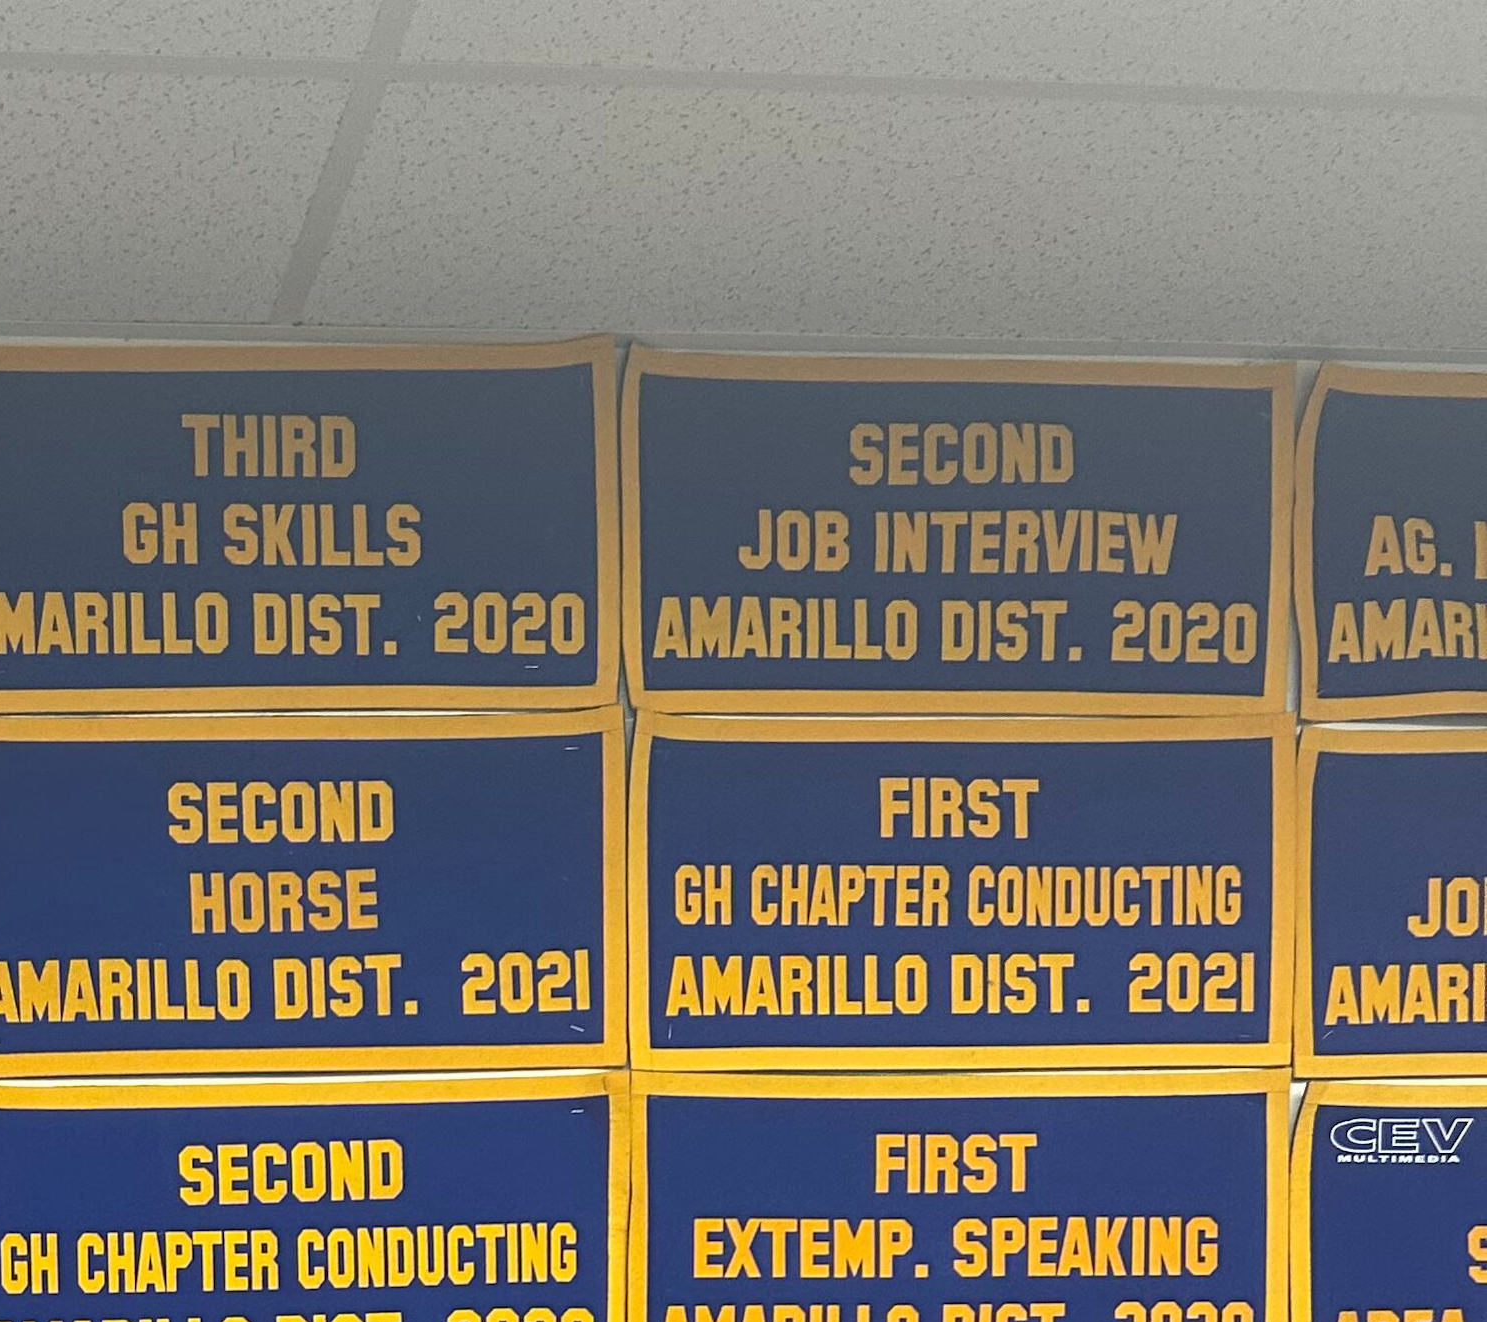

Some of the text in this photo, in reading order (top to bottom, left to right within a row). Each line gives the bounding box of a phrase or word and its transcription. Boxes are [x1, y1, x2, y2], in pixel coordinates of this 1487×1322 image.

[185, 415, 355, 477] THIRD
[850, 424, 1072, 484] SECOND
[123, 503, 421, 566] GH SKILLS
[739, 509, 1177, 574] JOB INTERVIEW
[1365, 516, 1452, 576] AG.
[253, 593, 397, 655] DIST.
[434, 592, 585, 654] 2020
[653, 596, 1257, 664] AMARILLO DIST. 2020
[168, 781, 394, 844] SECOND
[880, 777, 1039, 839] FIRST
[190, 869, 378, 934] HORSE
[675, 864, 1241, 927] GH CHAPTER CONDUCTING
[273, 954, 417, 1019] DIST.
[461, 950, 590, 1015] 2021
[666, 952, 1255, 1016] AMARILLO DIST. 2021
[875, 1133, 1038, 1194] FIRST
[1330, 1118, 1474, 1154] CEV
[1337, 1152, 1460, 1163] MULTIMEDIA
[179, 1139, 403, 1206] SECOND
[0, 1222, 577, 1294] GH CHAPTER CONDUCTING
[693, 1216, 1218, 1278] EXTEMP. SPEAKING
